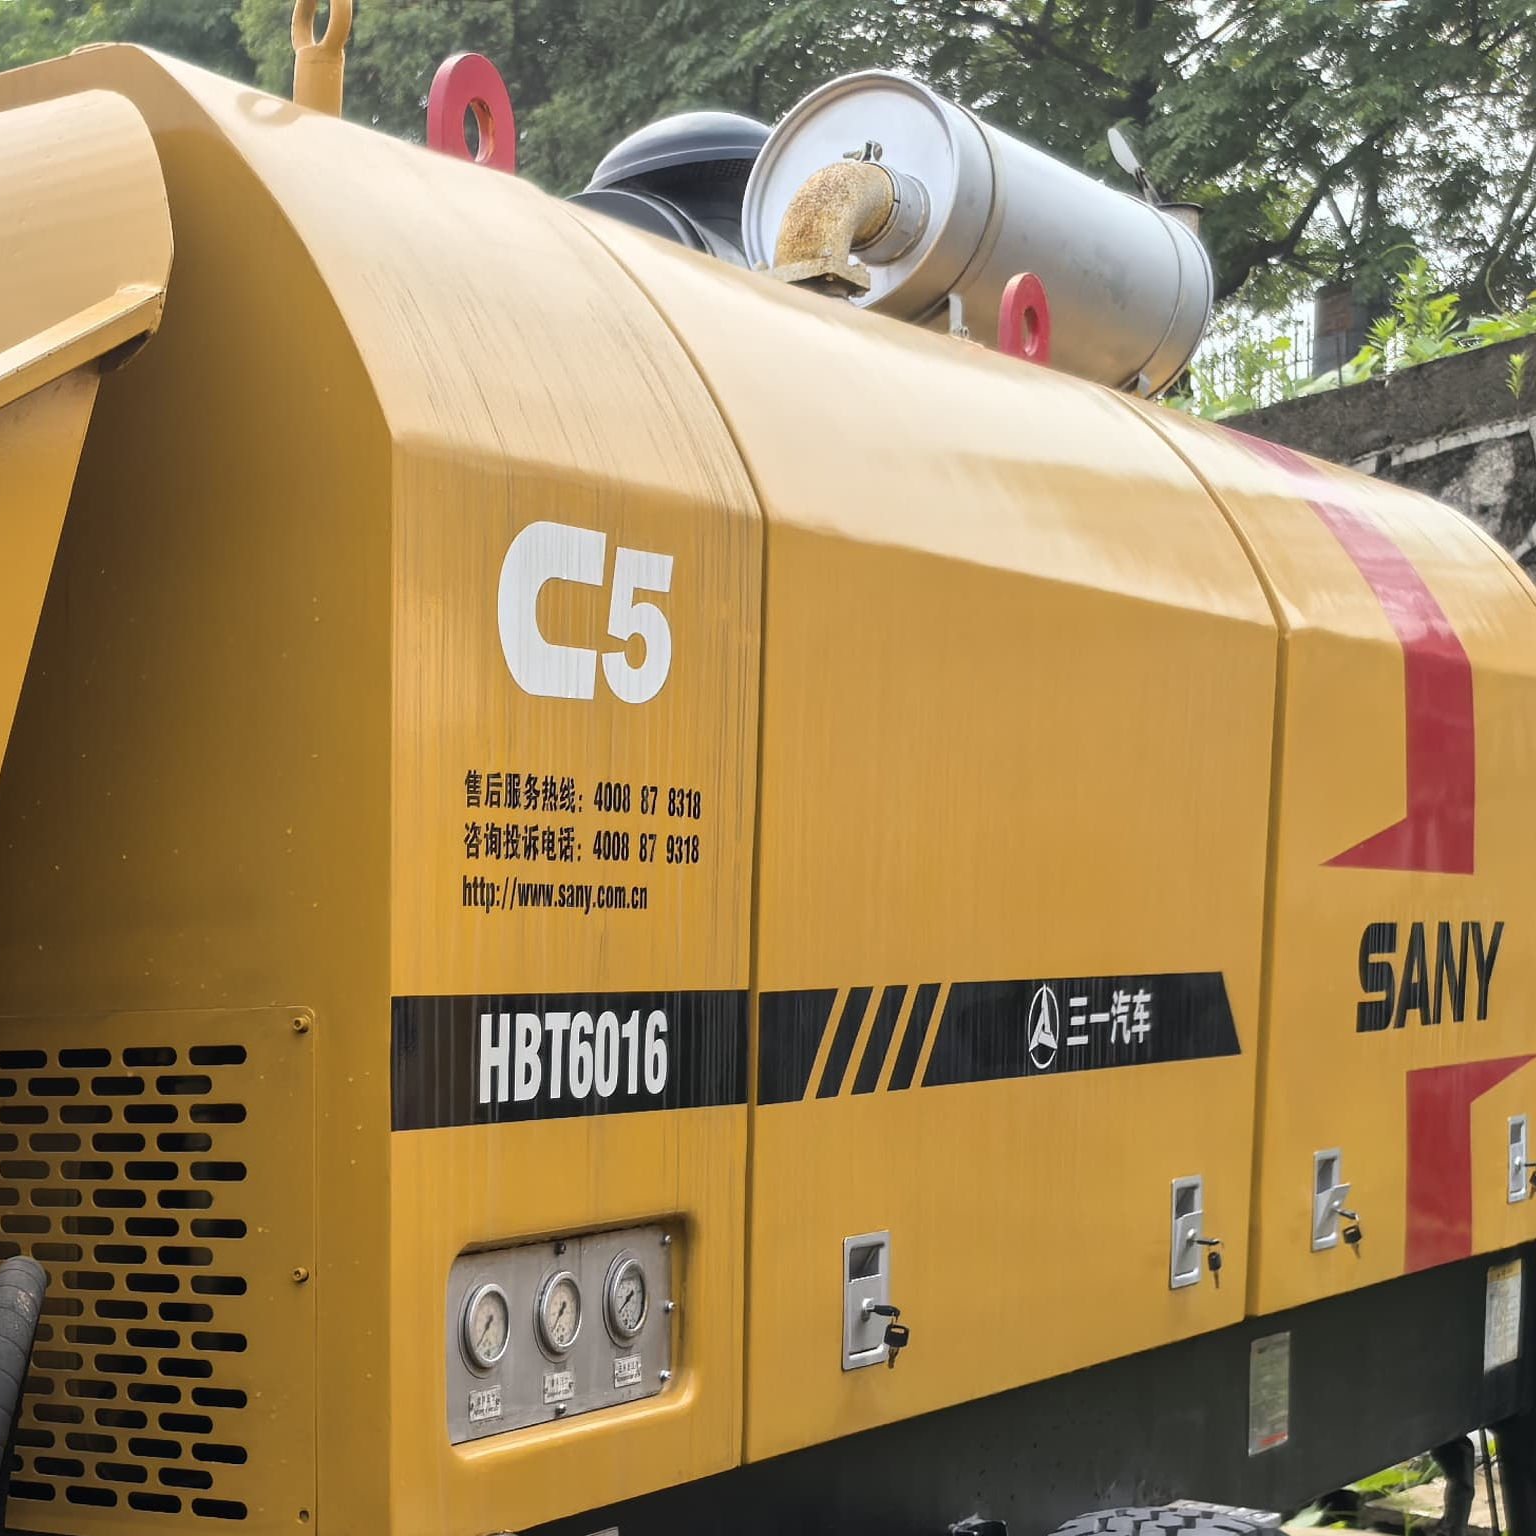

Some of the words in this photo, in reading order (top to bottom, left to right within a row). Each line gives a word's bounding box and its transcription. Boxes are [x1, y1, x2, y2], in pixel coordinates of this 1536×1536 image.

[498, 521, 674, 704] C5
[594, 781, 631, 813] 4008
[640, 785, 658, 815] 87
[667, 787, 701, 820] 8318
[593, 830, 630, 861] 4008
[639, 833, 657, 863] 87
[666, 834, 700, 864] 9318
[462, 875, 648, 915] http://www.sany.com.cn
[1356, 920, 1505, 1033] SANY
[1066, 989, 1151, 1046] 三一汽车
[479, 1010, 669, 1104] HBT6016
